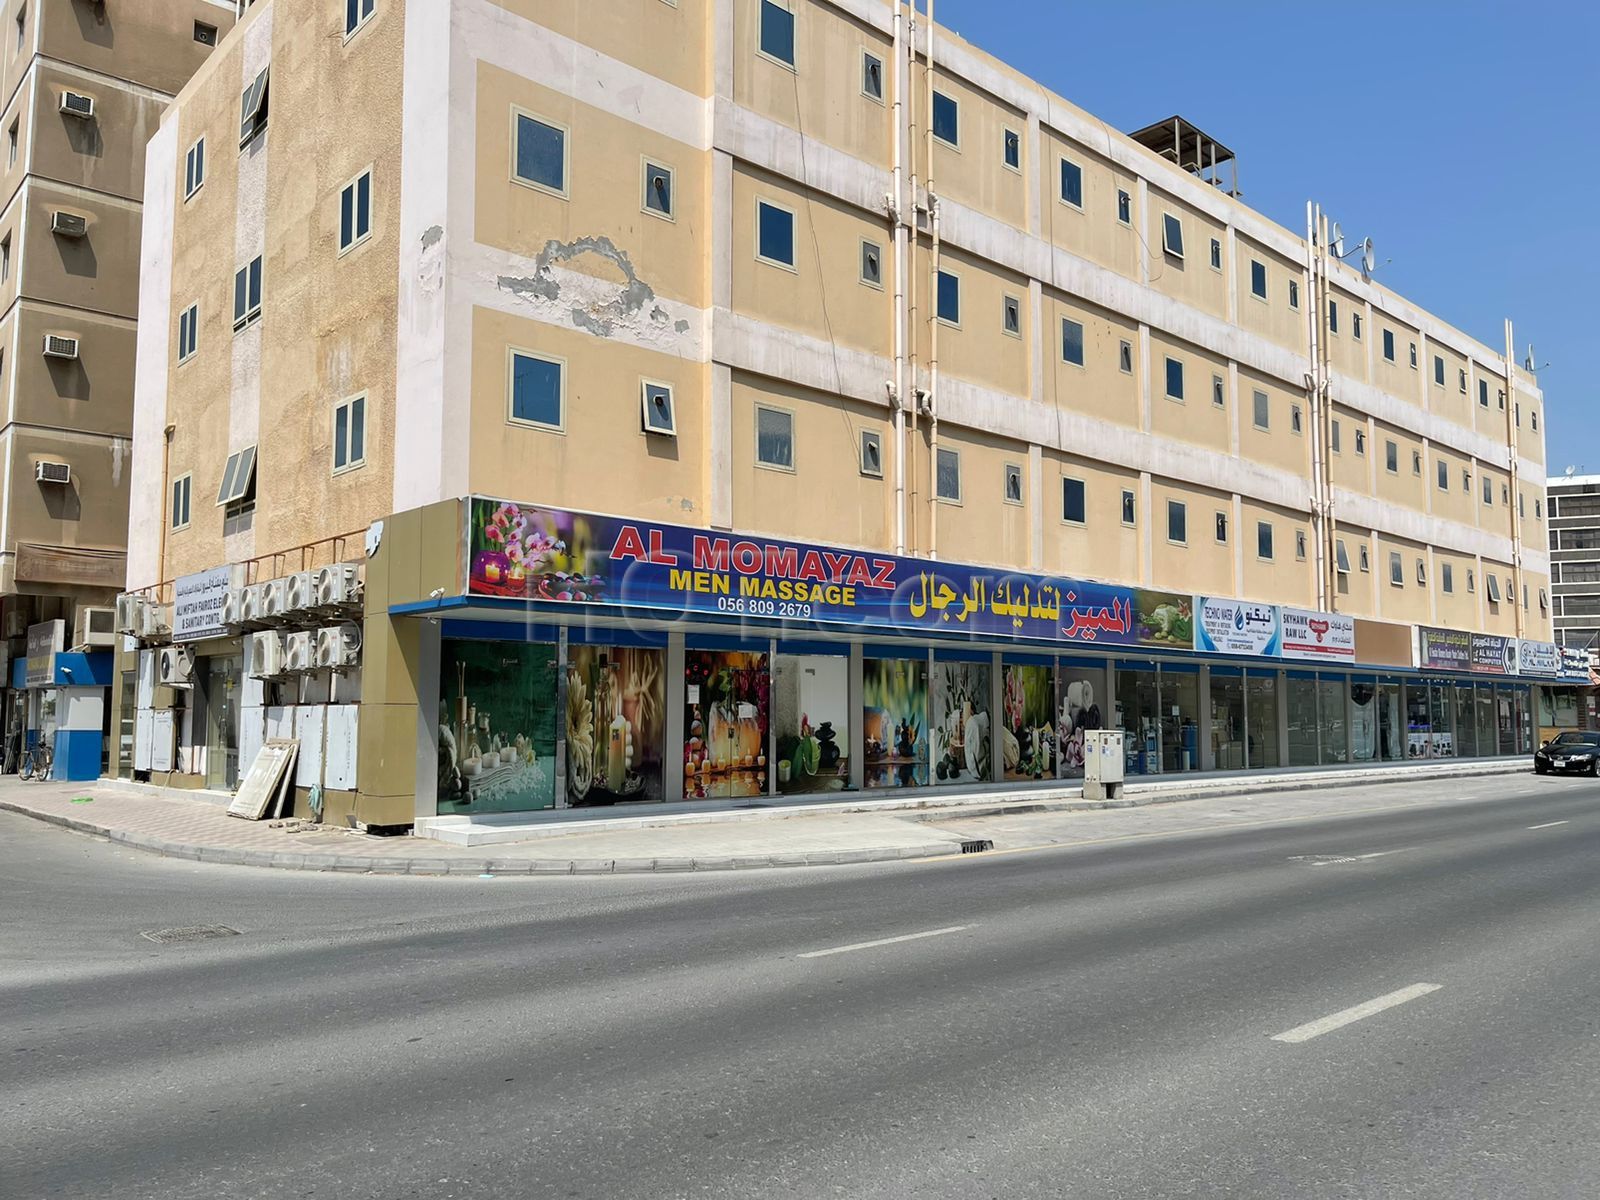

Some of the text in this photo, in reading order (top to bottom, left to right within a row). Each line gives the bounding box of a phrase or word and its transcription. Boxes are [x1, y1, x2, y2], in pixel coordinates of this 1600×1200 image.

[609, 525, 897, 590] AL MOMAYAZ
[669, 569, 856, 606] MEN MASSAGE
[909, 569, 985, 623] الرجال
[718, 597, 811, 618] 056 809 2679
[990, 578, 1061, 628] لتدليك
[1282, 613, 1308, 626] SKYHAWK
[1285, 627, 1297, 639] RAW
[1298, 629, 1307, 640] LLC
[1479, 648, 1486, 657] AL
[1479, 657, 1502, 666] COMPUTER
